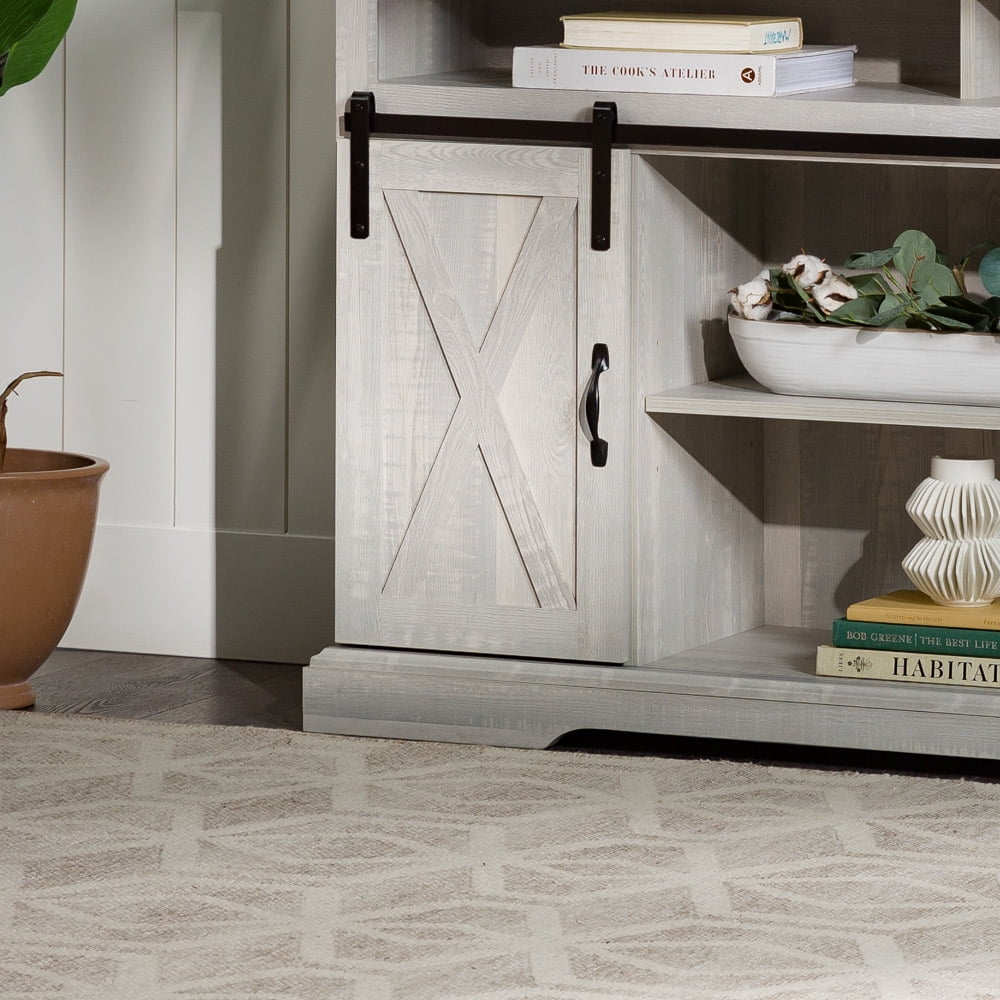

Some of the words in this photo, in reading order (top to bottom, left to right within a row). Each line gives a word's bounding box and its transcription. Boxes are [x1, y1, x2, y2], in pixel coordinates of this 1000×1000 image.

[582, 65, 607, 76] THE
[612, 66, 657, 78] COOK'S
[662, 68, 716, 80] ATELIER
[846, 631, 867, 641] BOB
[870, 632, 913, 644] GREENE
[919, 636, 942, 646] THE
[945, 638, 971, 648] BEST
[974, 640, 998, 650] LIFE
